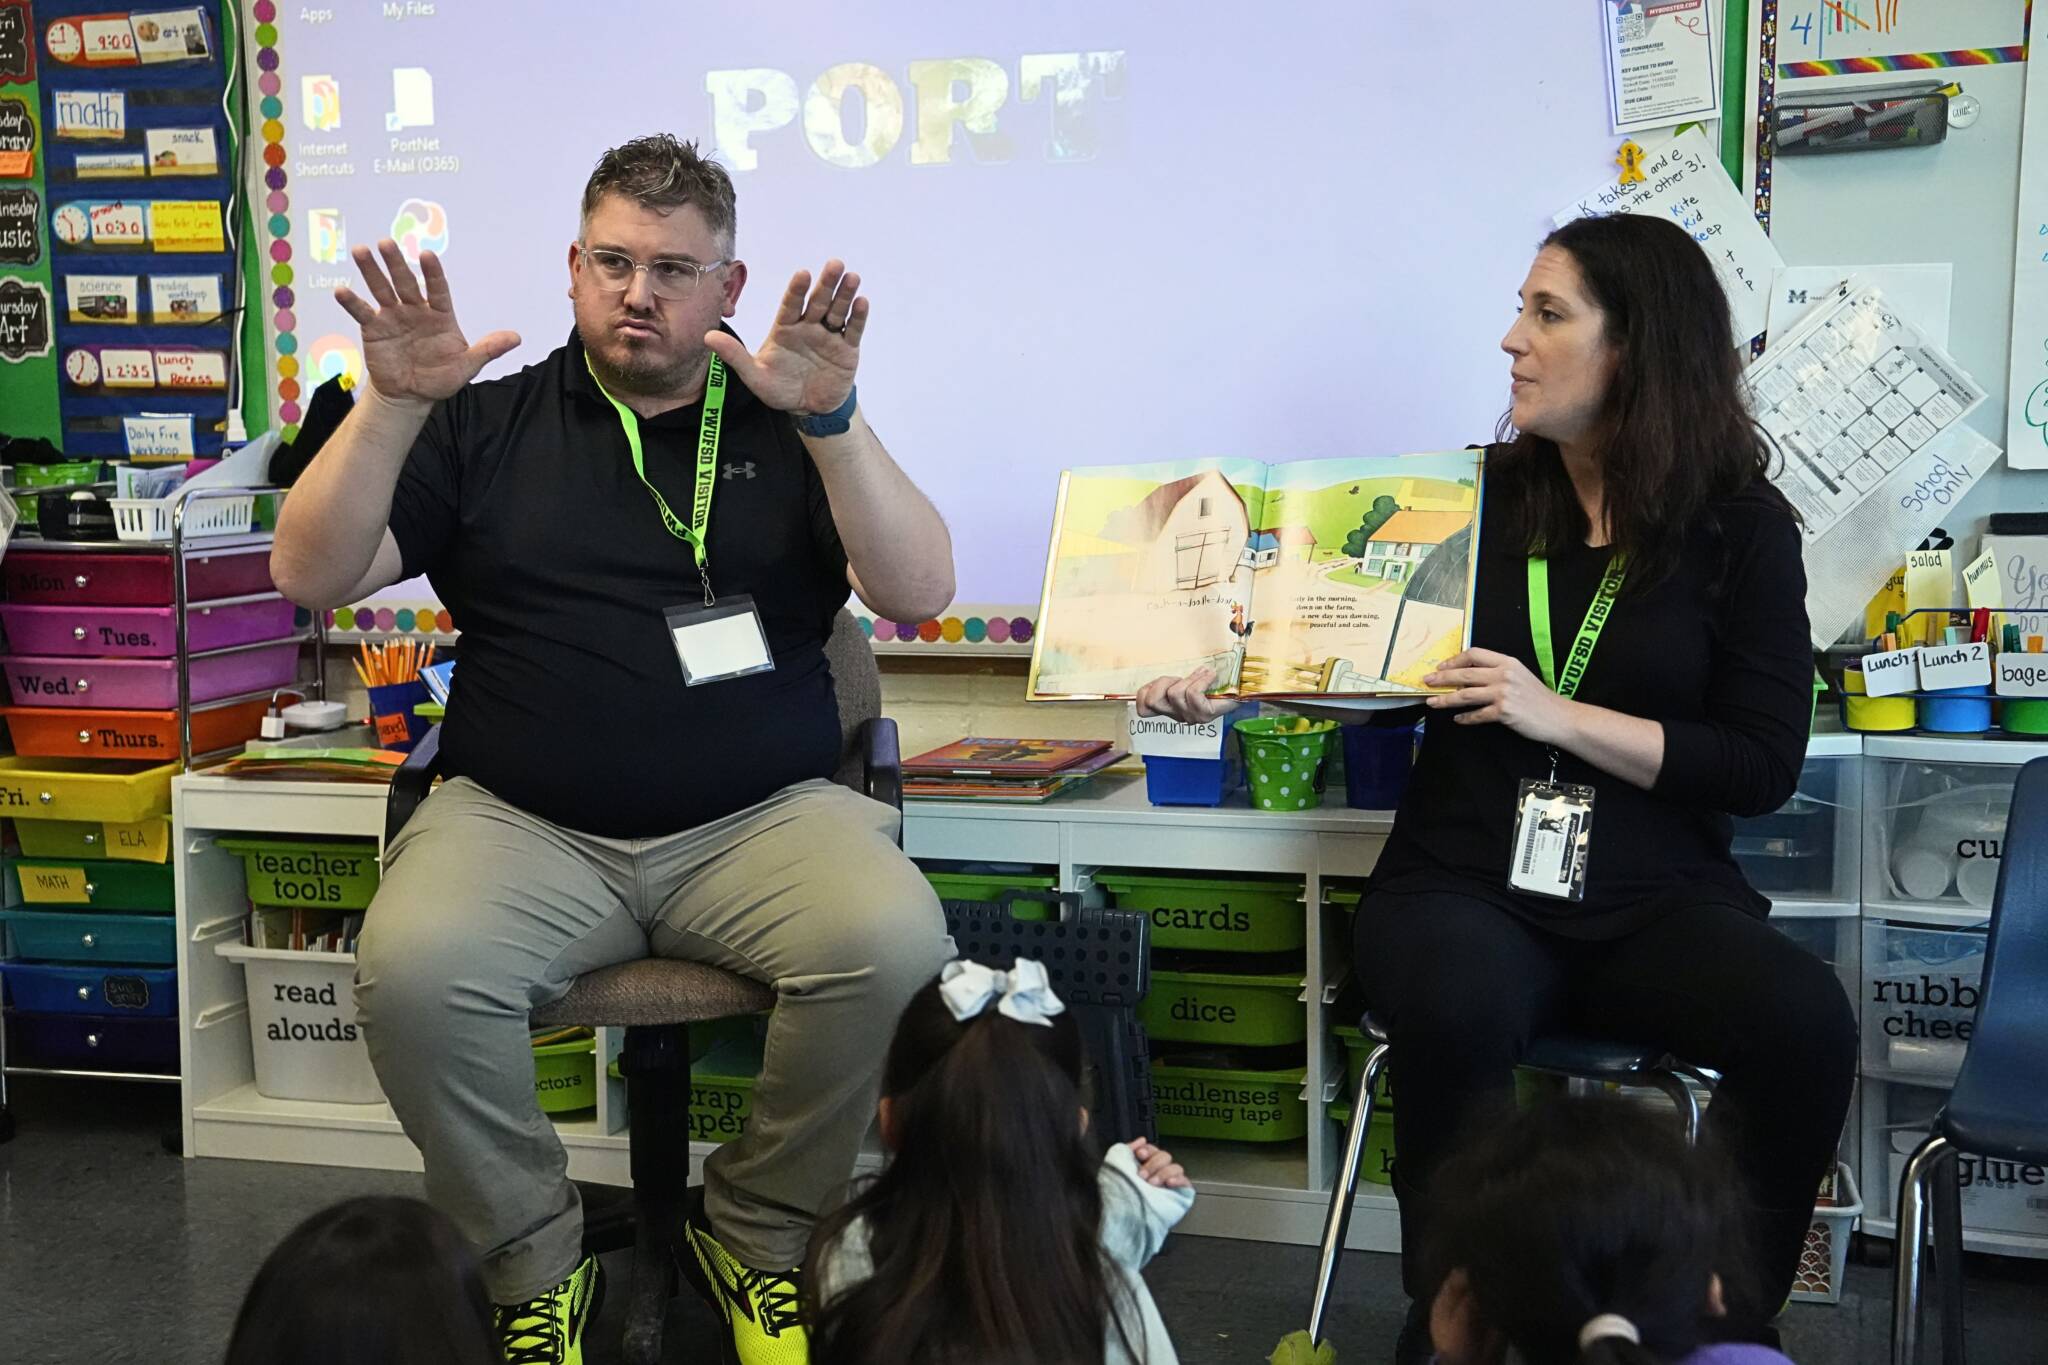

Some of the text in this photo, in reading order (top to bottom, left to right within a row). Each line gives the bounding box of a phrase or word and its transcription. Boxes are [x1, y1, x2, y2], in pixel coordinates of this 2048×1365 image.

[300, 8, 332, 23] Apps
[383, 2, 435, 20] My Files
[1790, 12, 1813, 45] 4
[60, 93, 119, 129] math
[705, 50, 1127, 171] PORT
[299, 143, 348, 156] Internet
[391, 138, 440, 152] PortNet
[296, 162, 355, 176] Shortcuts
[374, 158, 415, 173] E-Mail
[1598, 180, 1637, 206] takes
[1650, 154, 1668, 174] and
[1632, 190, 1654, 205] the
[1655, 169, 1684, 193] other
[1670, 195, 1699, 216] Kite
[1682, 209, 1704, 229] Kid
[1693, 223, 1722, 242] Keep
[80, 280, 123, 293] science
[308, 275, 352, 289] Library
[0, 315, 29, 343] Art
[158, 355, 194, 366] Lunch
[170, 372, 213, 386] Recess
[128, 425, 180, 442] Daily Five
[132, 442, 179, 457] Workshop
[695, 408, 719, 530] PWUFSD VISITOR
[1901, 454, 1952, 512] School
[1933, 464, 1974, 505] Only
[1910, 552, 1942, 568] salad
[19, 574, 71, 592] Mon.
[98, 628, 157, 647] Tues.
[1868, 652, 1909, 673] Lunch
[1922, 646, 1984, 668] Lunch 2
[18, 676, 76, 695] Wed.
[2002, 664, 2048, 687] bage
[97, 729, 165, 748] Thurs.
[0, 787, 30, 806] Fri.
[120, 831, 147, 847] ELA
[255, 853, 362, 877] teacher
[37, 874, 69, 889] MATH
[273, 877, 342, 902] tools
[1151, 904, 1250, 933] cards
[274, 982, 338, 1006] read
[1873, 975, 1979, 1009] rubb
[1170, 998, 1237, 1024] dice
[267, 1018, 358, 1041] alouds
[1883, 1010, 1974, 1041] chee
[1198, 1082, 1280, 1106] lenses
[1241, 1106, 1283, 1126] tape
[1959, 1155, 2046, 1188] glue
